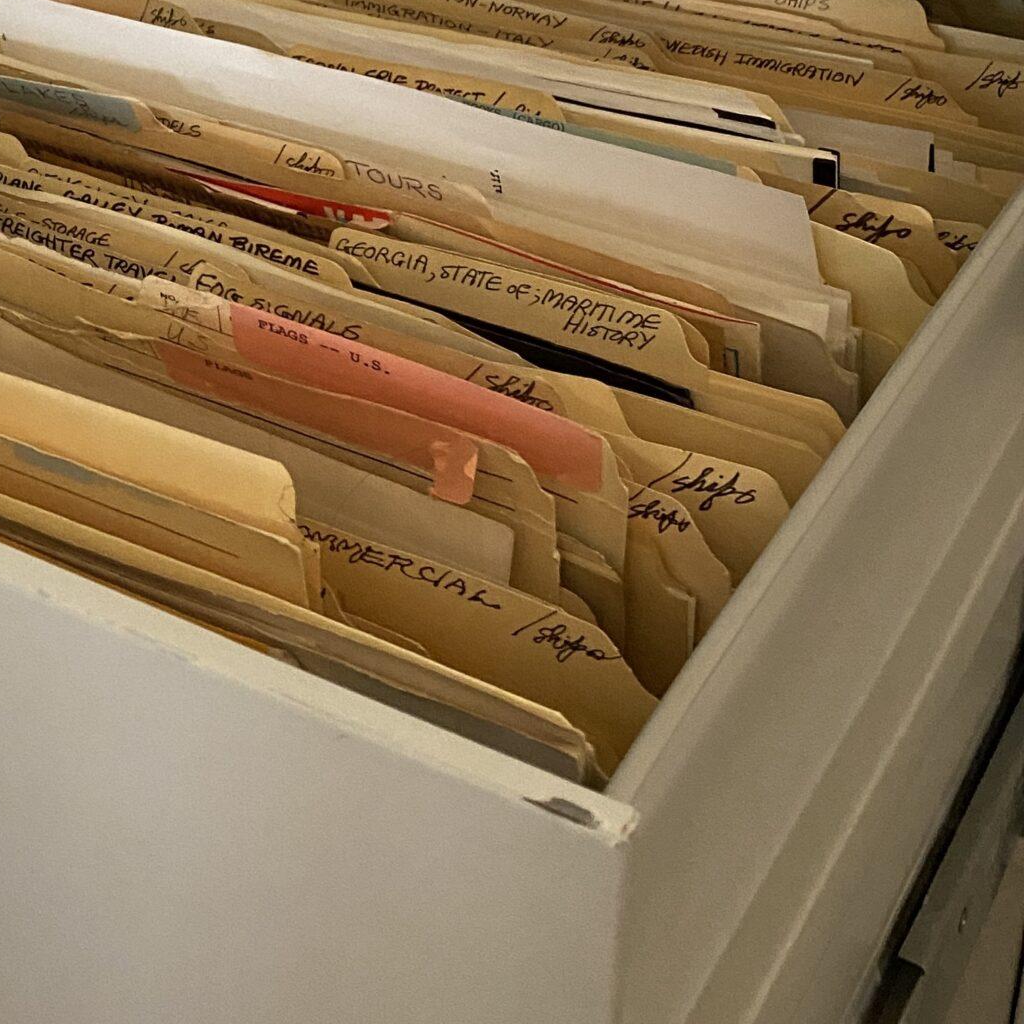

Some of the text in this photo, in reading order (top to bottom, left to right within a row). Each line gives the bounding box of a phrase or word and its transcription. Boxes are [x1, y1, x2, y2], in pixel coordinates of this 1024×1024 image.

[734, 52, 865, 86] IMMIGRATION
[345, 160, 444, 201] TOURS
[229, 236, 320, 276] BIREME
[335, 237, 436, 282] GEORGIA,
[440, 265, 503, 291] STATE
[541, 289, 662, 330] MARITIME
[257, 320, 308, 344] FLAGS
[349, 351, 390, 375] U.S.
[563, 314, 656, 350] HISTORY
